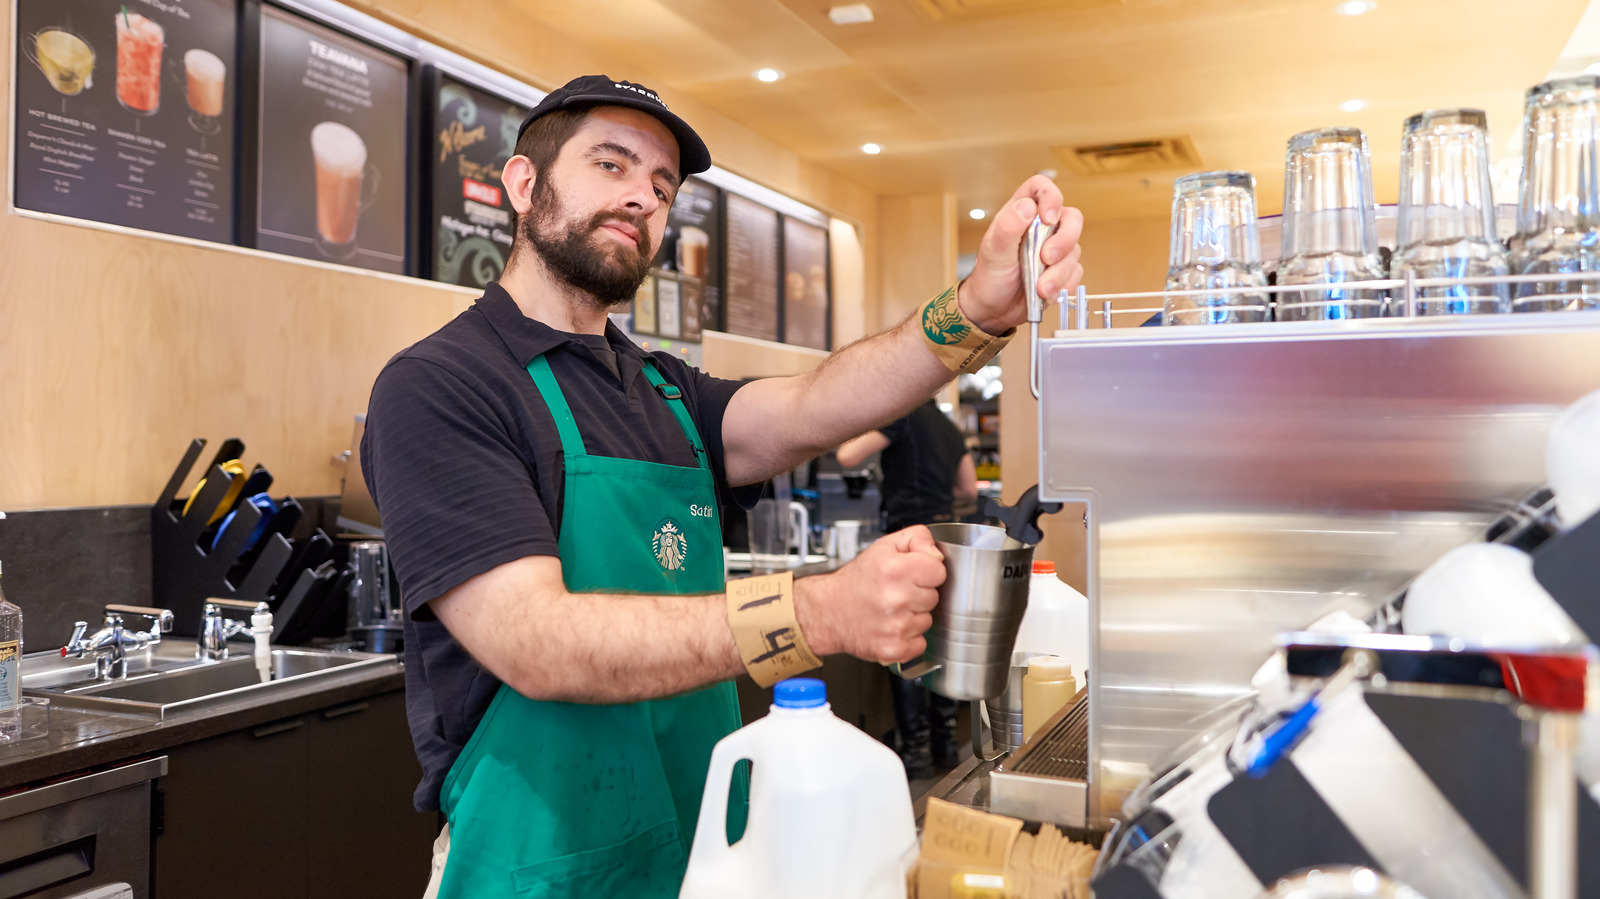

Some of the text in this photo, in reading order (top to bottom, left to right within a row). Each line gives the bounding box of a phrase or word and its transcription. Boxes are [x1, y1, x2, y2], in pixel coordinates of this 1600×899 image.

[28, 108, 97, 131] HOT BREWED TEA
